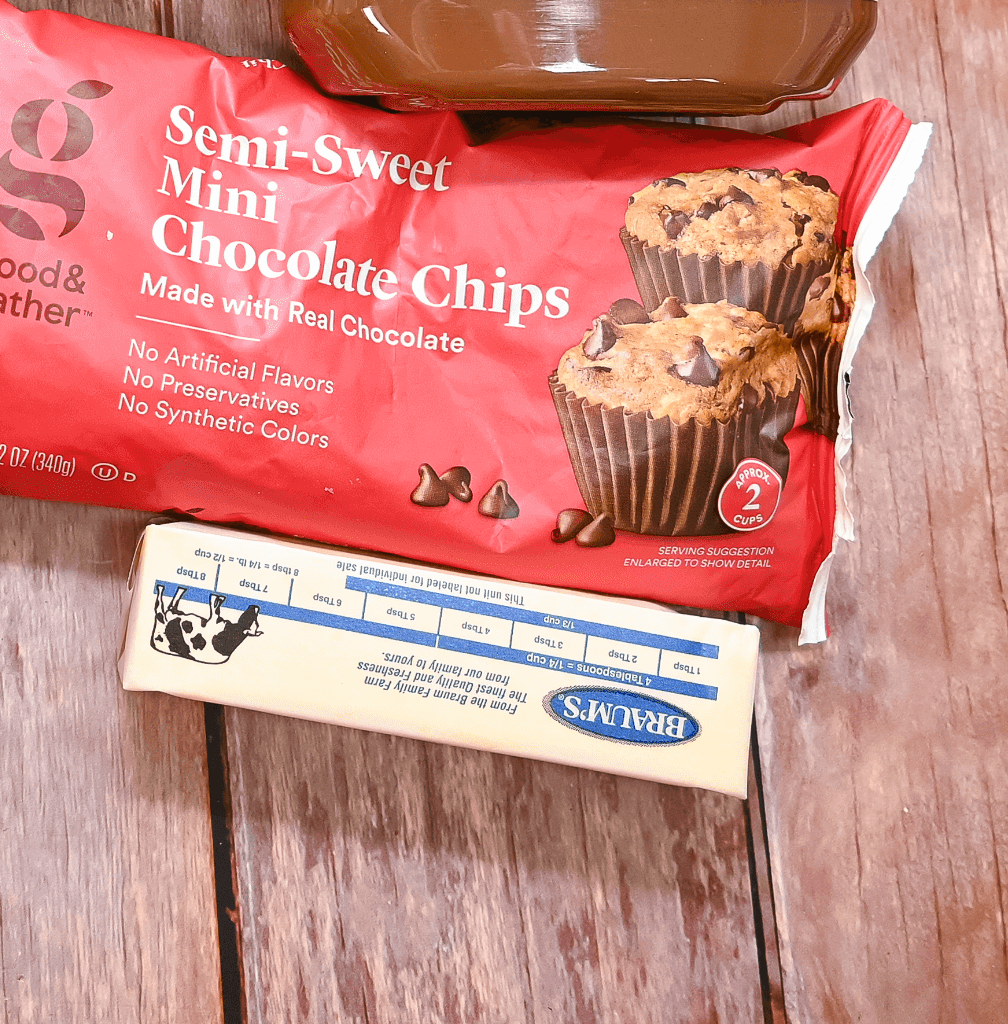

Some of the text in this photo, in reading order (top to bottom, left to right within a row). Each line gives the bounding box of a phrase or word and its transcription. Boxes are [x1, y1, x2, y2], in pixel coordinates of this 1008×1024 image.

[165, 104, 452, 192] Semi-Sweet
[156, 155, 278, 224] Mini
[151, 213, 570, 328] Chocolate Chips
[140, 273, 465, 354] Made with Real Chocolate
[128, 339, 334, 395] No Artificial Flavors
[122, 366, 300, 416] No Preservatives
[117, 393, 330, 449] No Synthetic Colors
[10, 447, 29, 468] OZ
[31, 451, 76, 477] (340g)
[735, 468, 771, 489] APPROX.
[742, 484, 761, 511] 2
[733, 514, 763, 525] CUPS
[195, 548, 212, 559] cup
[214, 553, 226, 563] 1/2
[237, 558, 247, 567] lb.
[249, 560, 261, 570] 1/4
[624, 558, 771, 568] ENLARGED TO SHOW DETAIL
[658, 546, 774, 556] SERVING SUGGESTION
[177, 567, 206, 581] 8 Tbsp
[272, 563, 292, 575] tbsp
[337, 560, 524, 606] This unit not labeled for individual sale
[239, 579, 261, 592] Tbsp
[544, 615, 575, 629] 1/3 cup
[357, 661, 527, 703] The finest Quality and Freshness
[382, 652, 510, 686] from our family to yours.
[526, 652, 651, 685] 4 Tablespoons 1/4 cup
[674, 662, 695, 674] Tbsp
[364, 676, 518, 715] From the Braum Family Farm
[564, 695, 687, 738] BRAUM'S
